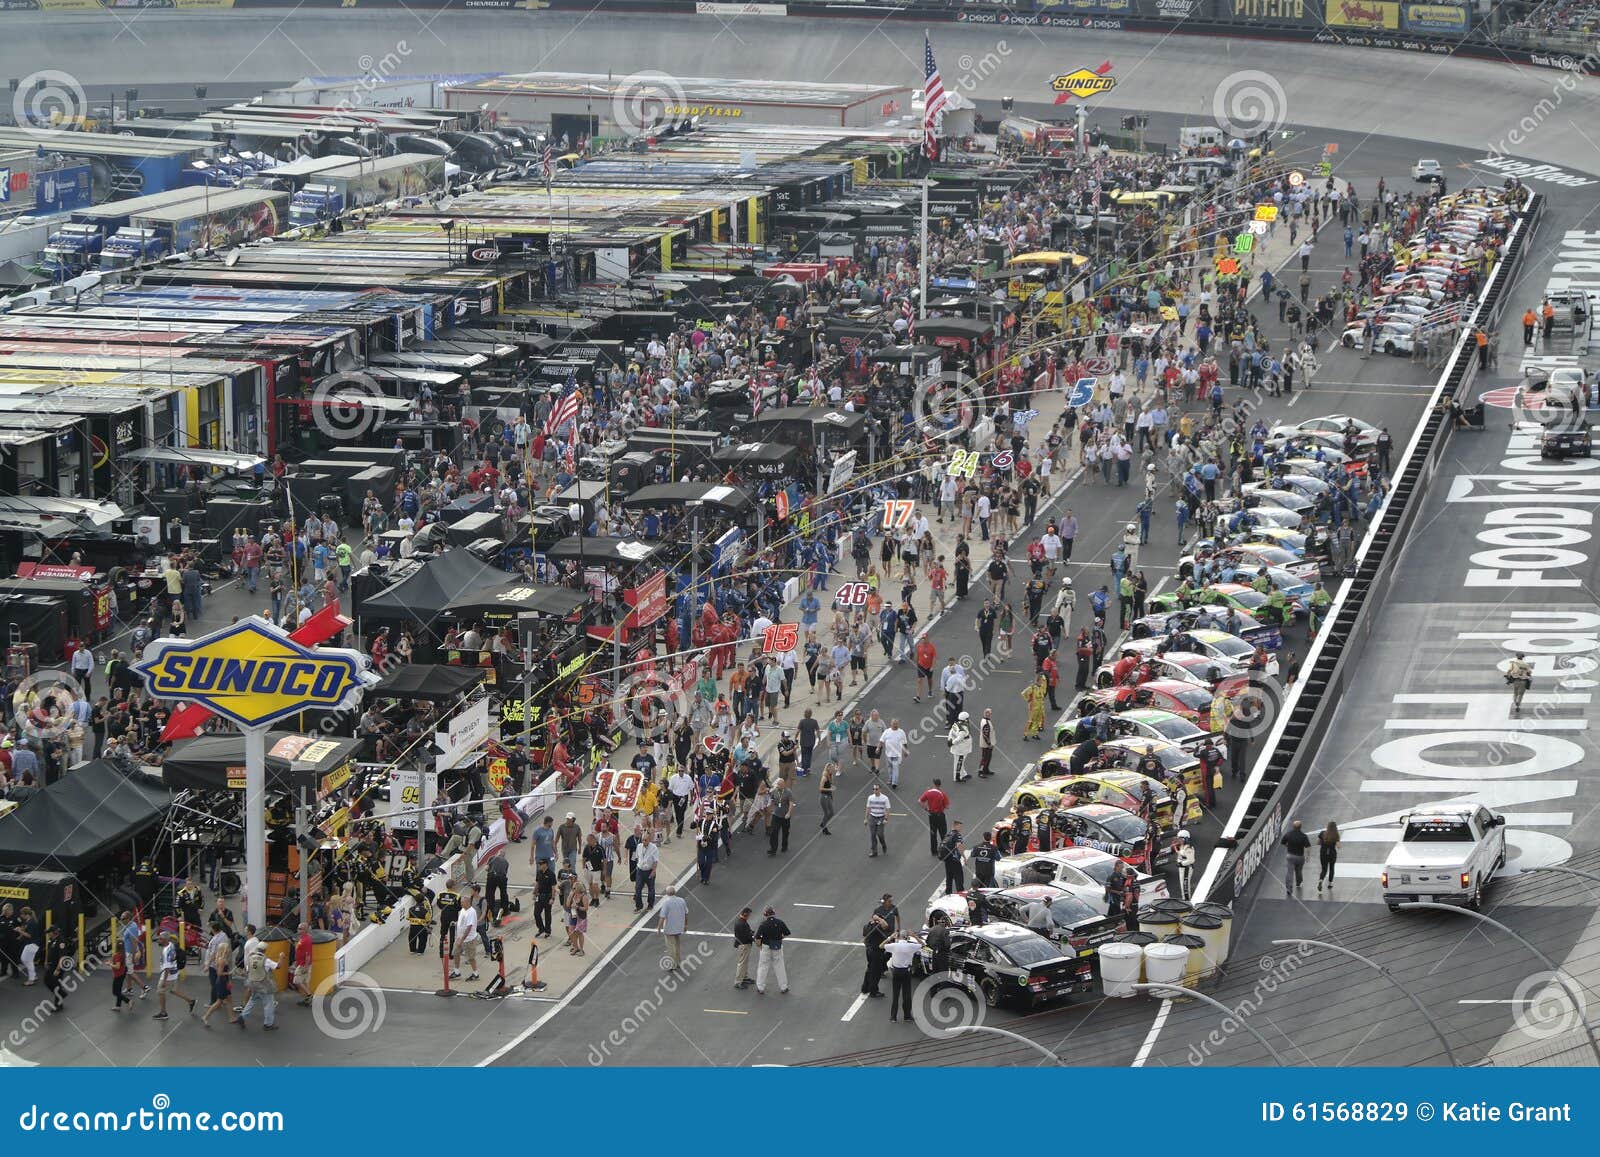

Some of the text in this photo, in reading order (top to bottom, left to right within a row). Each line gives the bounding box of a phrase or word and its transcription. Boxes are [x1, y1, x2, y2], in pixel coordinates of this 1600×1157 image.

[969, 13, 1121, 29] pepsi pepsi pepsi pepsi
[1316, 34, 1335, 42] Sprint
[1346, 36, 1363, 44] Sprint
[1374, 38, 1392, 47] Sprint
[1402, 41, 1419, 49] Sprint
[1055, 77, 1112, 90] SUNOCO
[664, 105, 743, 117] GOODYEAR
[1235, 233, 1253, 252] 10
[1069, 378, 1097, 407] 5
[947, 449, 979, 479] 24
[992, 450, 1013, 467] 6
[883, 500, 914, 528] 17
[1463, 507, 1593, 587] FOOD
[835, 582, 869, 605] 46
[762, 623, 799, 653] 15
[158, 655, 344, 698] SUNOCO
[592, 769, 644, 810] 19
